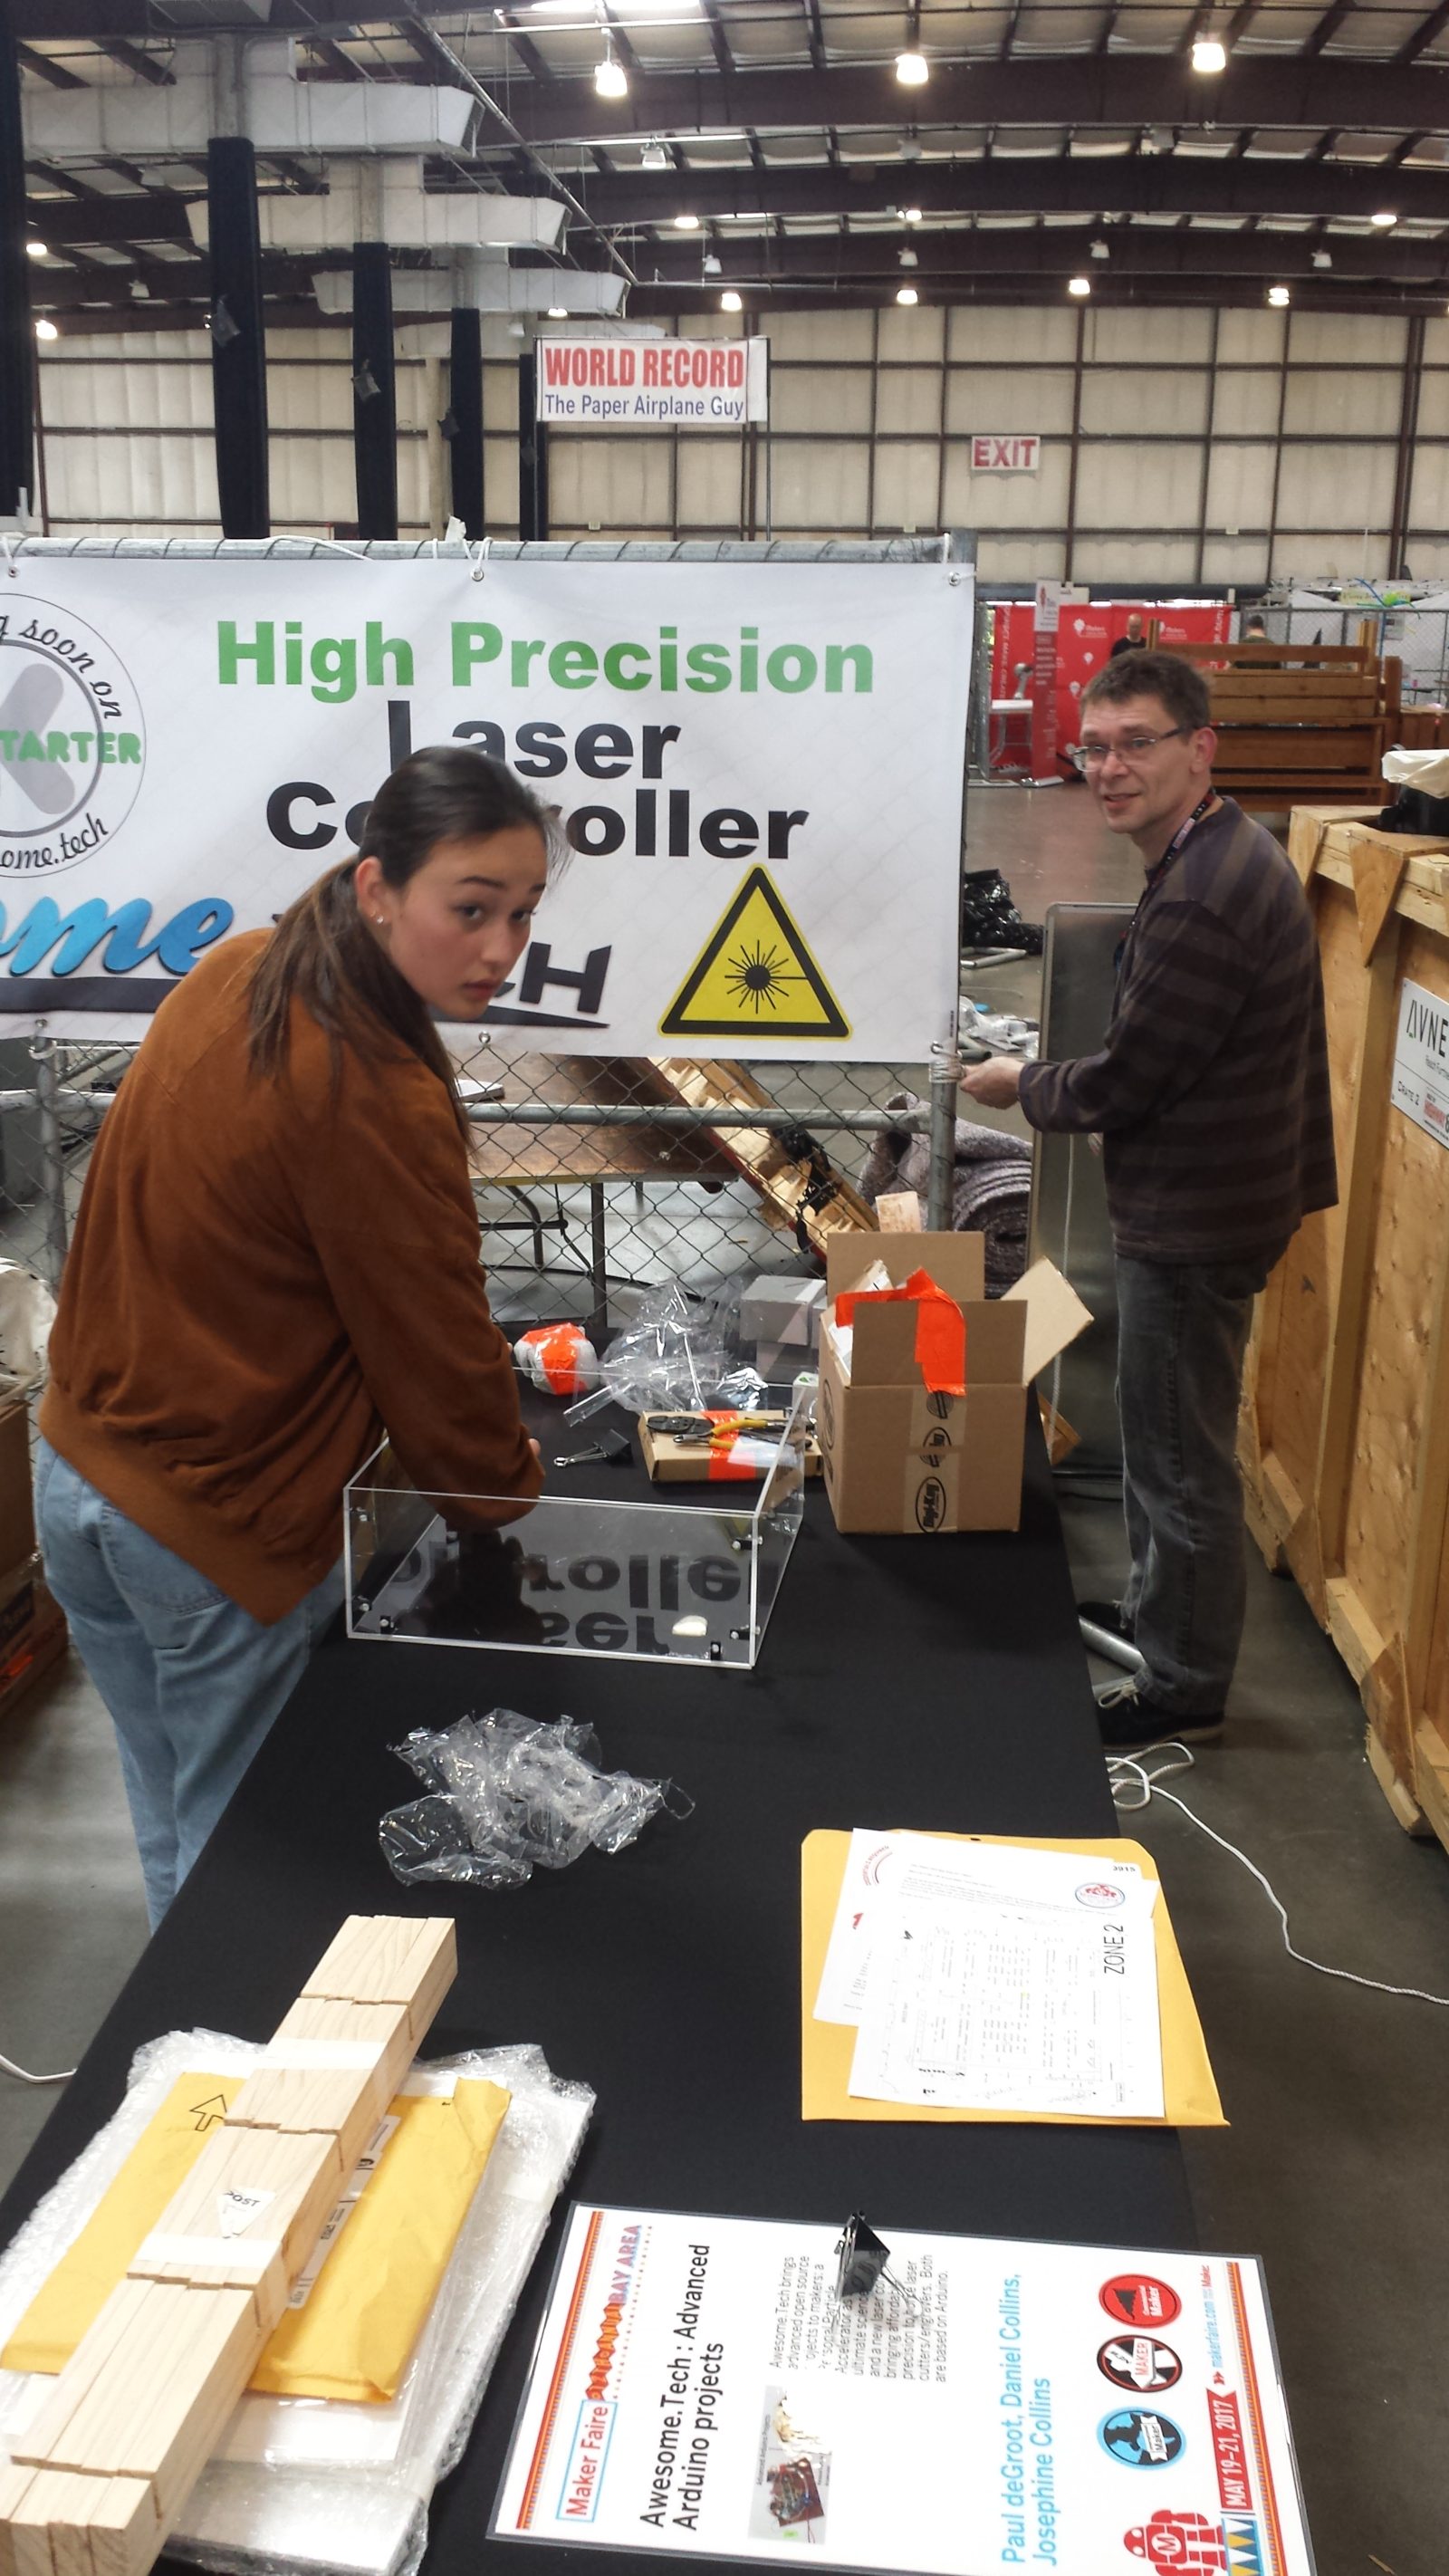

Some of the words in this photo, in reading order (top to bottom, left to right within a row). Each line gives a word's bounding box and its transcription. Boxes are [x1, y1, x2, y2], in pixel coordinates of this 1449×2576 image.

[545, 347, 635, 388] WORLD
[642, 348, 744, 389] RECORD
[545, 394, 575, 414] The
[581, 395, 630, 419] Paper
[634, 395, 705, 419] Airplane
[710, 396, 744, 420] Guy
[974, 439, 1037, 466] EXIT
[19, 620, 95, 674] soon
[90, 681, 123, 719] on
[217, 620, 415, 704] High
[451, 621, 873, 694] Precision
[266, 782, 810, 860] Coller
[1103, 1924, 1124, 1932] 2
[1103, 1937, 1125, 1975] ZONE
[616, 2225, 643, 2268] AREA
[919, 2254, 933, 2279] Both
[608, 2270, 632, 2306] BAY
[779, 2256, 797, 2287] brings
[797, 2255, 810, 2289] source
[905, 2261, 917, 2283] laser
[934, 2270, 949, 2312] Arduino.
[794, 2292, 807, 2318] open
[807, 2315, 820, 2326] to
[871, 2298, 885, 2321] laser
[936, 2315, 947, 2328] on
[999, 2274, 1022, 2341] Collins,
[769, 2290, 791, 2369] Awesome.Tech
[787, 2319, 804, 2369] advanced
[805, 2329, 820, 2369] ojects
[819, 2324, 834, 2369] esonal
[834, 2314, 851, 2374] Accelerator
[872, 2325, 883, 2346] new
[934, 2331, 947, 2363] based
[1204, 2301, 1223, 2368] makerfaire.com
[853, 2331, 867, 2376] ultimate
[869, 2357, 881, 2378] and
[884, 2336, 901, 2379] bringing
[903, 2330, 916, 2379] precision
[936, 2366, 946, 2382] are
[1134, 2342, 1149, 2376] MAKER
[639, 2358, 692, 2528] Awesome.Tech
[673, 2244, 710, 2340] Advanced
[999, 2346, 1022, 2408] Daniel
[581, 2406, 609, 2450] Faire
[1029, 2378, 1052, 2446] Collins
[1213, 2399, 1237, 2430] 2017
[672, 2437, 710, 2531] Arduino
[694, 2343, 724, 2430] projects
[1153, 2426, 1165, 2451] Maker
[1001, 2415, 1025, 2506] deGroot,
[566, 2456, 598, 2515] Maker
[1223, 2477, 1248, 2506] MAY
[1031, 2454, 1061, 2567] Josephine
[1001, 2514, 1025, 2562] Paul
[1157, 2537, 1176, 2552] M
